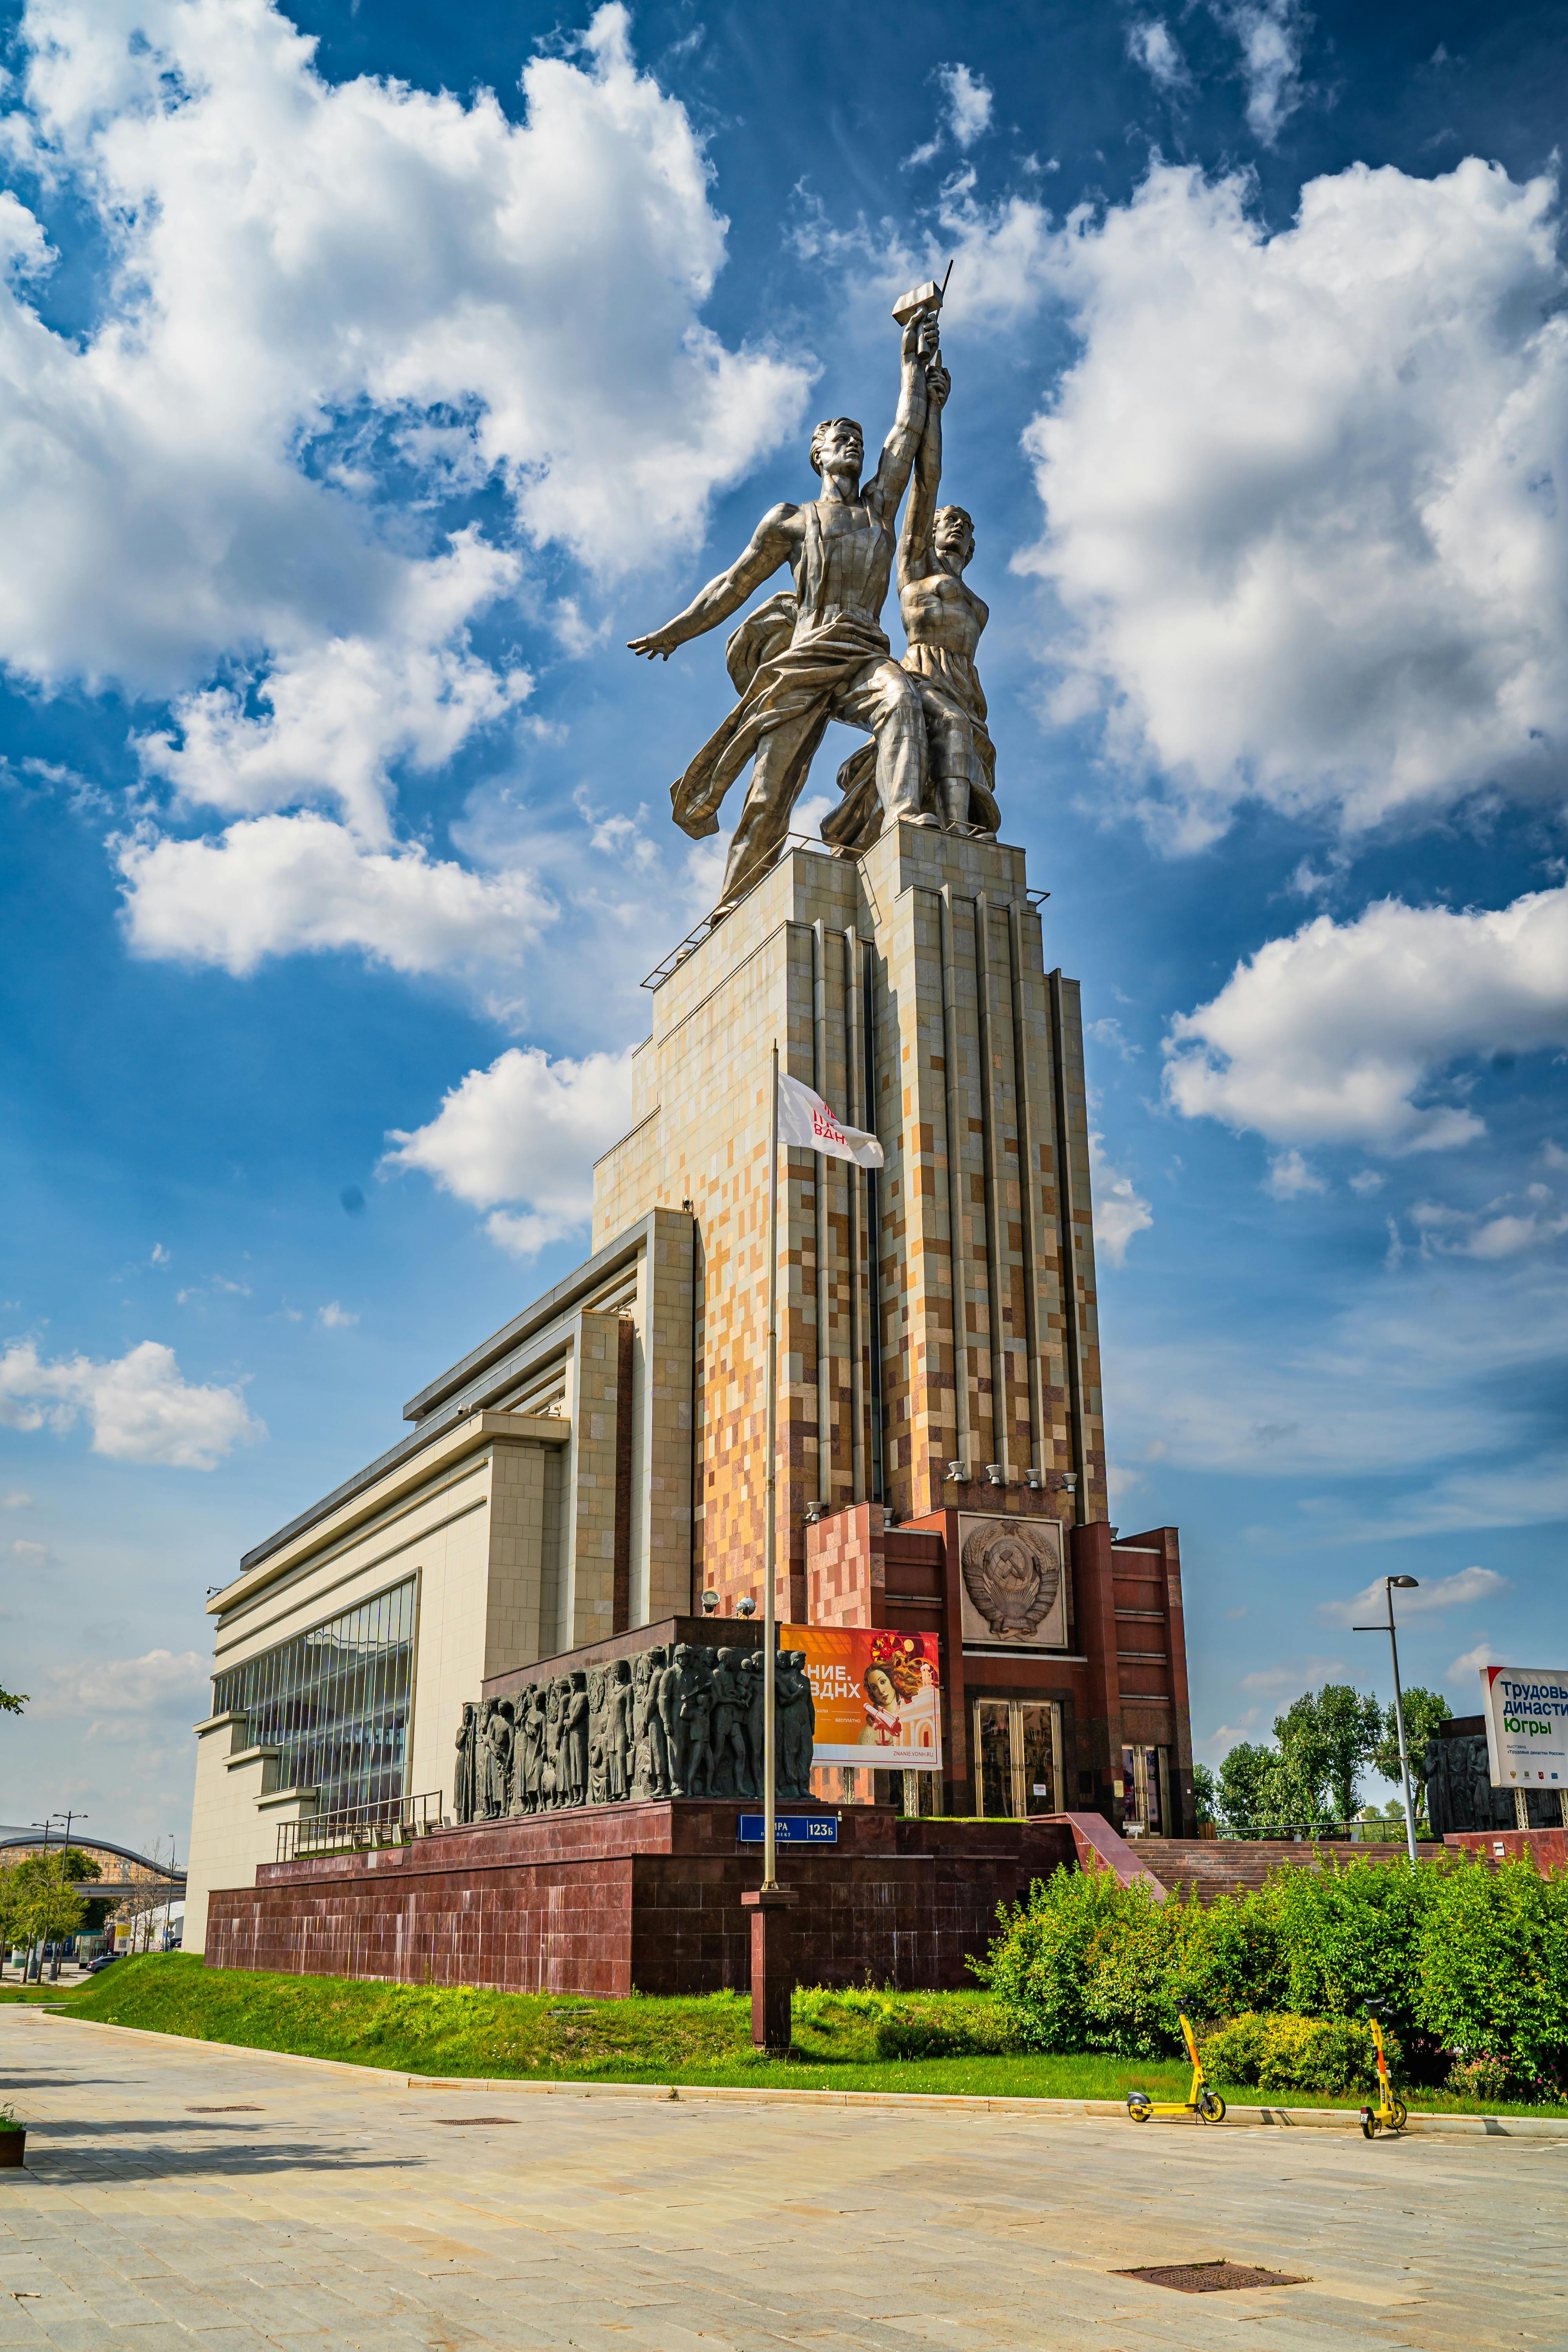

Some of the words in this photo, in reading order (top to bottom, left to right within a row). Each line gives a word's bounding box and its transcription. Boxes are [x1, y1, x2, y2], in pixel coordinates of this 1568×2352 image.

[814, 1123, 849, 1146] ВДН
[810, 1681, 861, 1700] ВДНХ
[1504, 1717, 1552, 1737] Югры
[809, 1824, 833, 1835] 123Б
